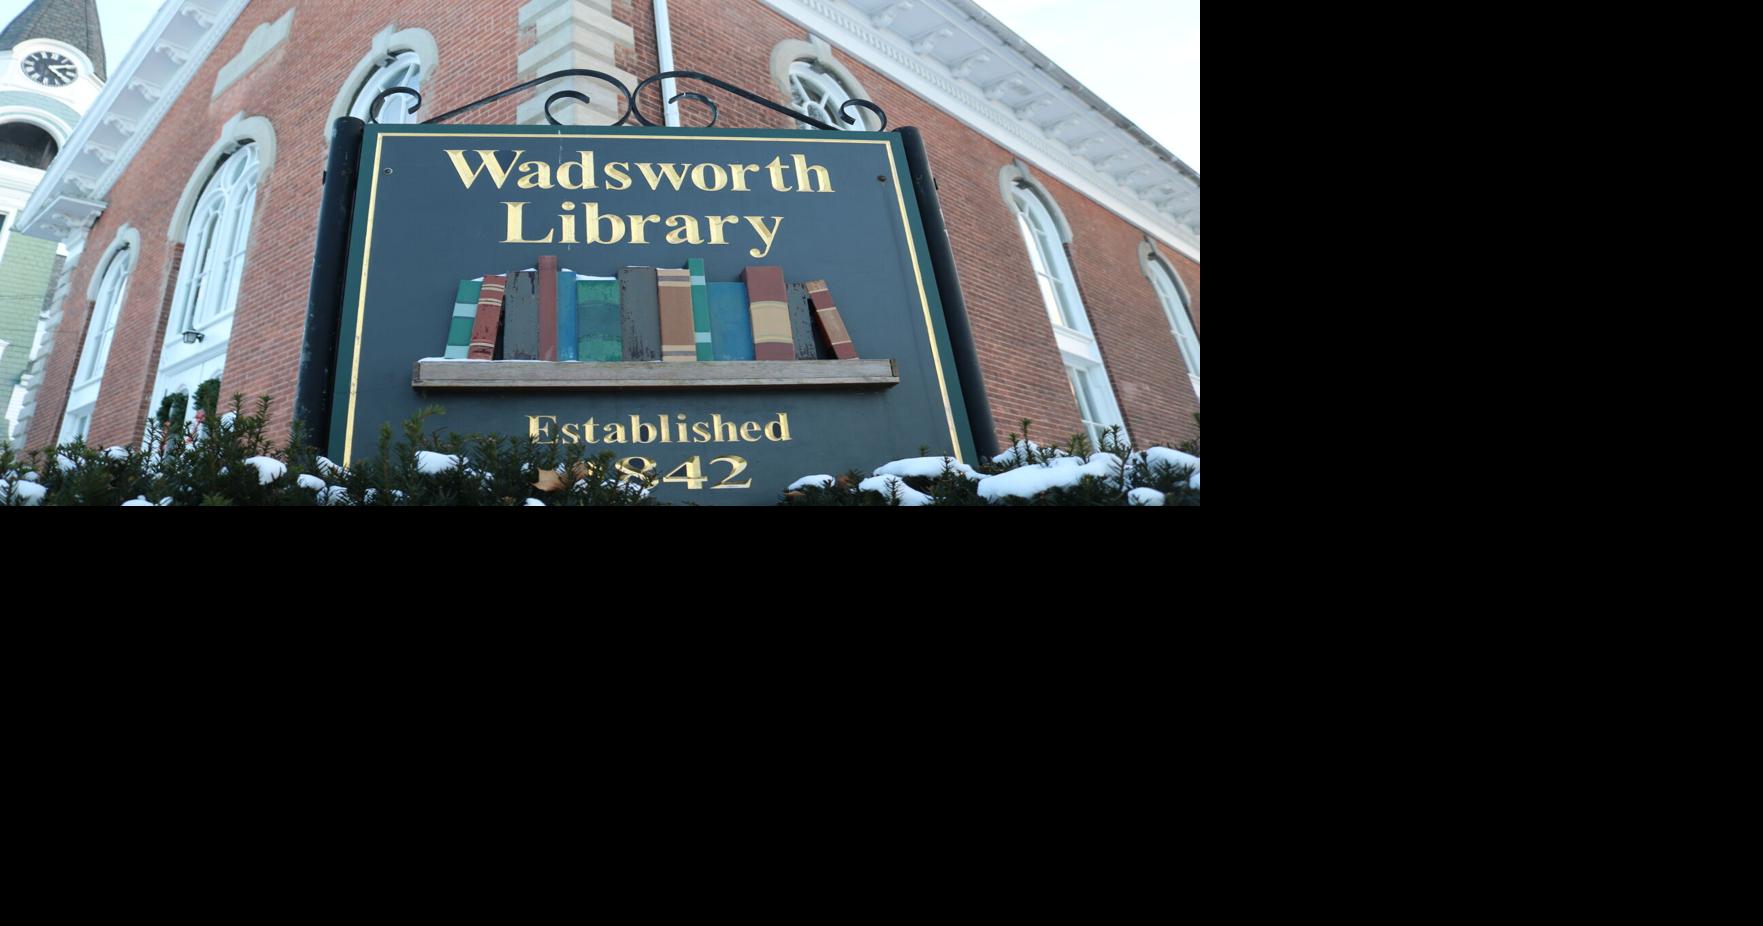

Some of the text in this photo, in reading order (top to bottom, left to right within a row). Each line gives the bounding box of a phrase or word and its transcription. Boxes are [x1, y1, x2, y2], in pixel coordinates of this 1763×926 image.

[444, 149, 835, 193] Wadsworth
[500, 201, 784, 258] Library
[526, 412, 792, 444] Established
[586, 455, 752, 491] 842
